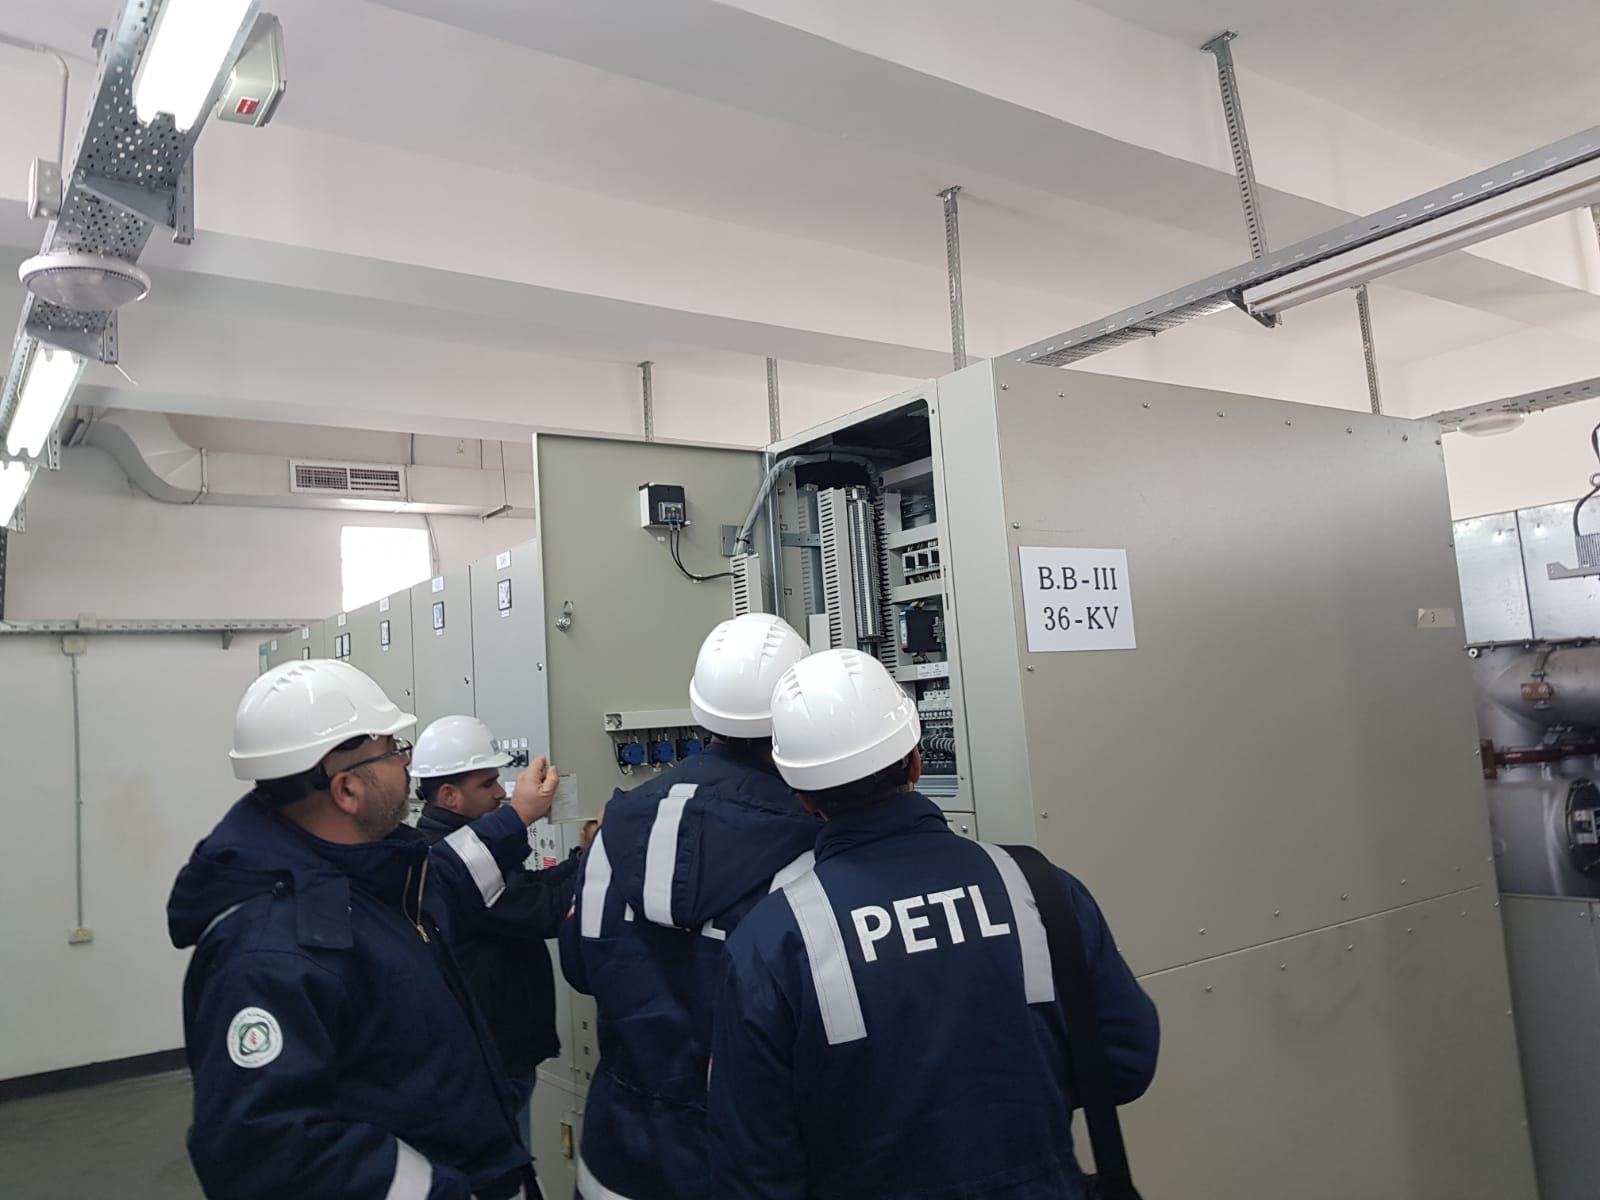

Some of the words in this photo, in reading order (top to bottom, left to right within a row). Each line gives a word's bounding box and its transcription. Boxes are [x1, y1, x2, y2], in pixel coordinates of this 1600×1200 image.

[1037, 566, 1118, 591] B.B-III
[1043, 606, 1119, 631] 36-KV
[850, 884, 1011, 963] PETL
